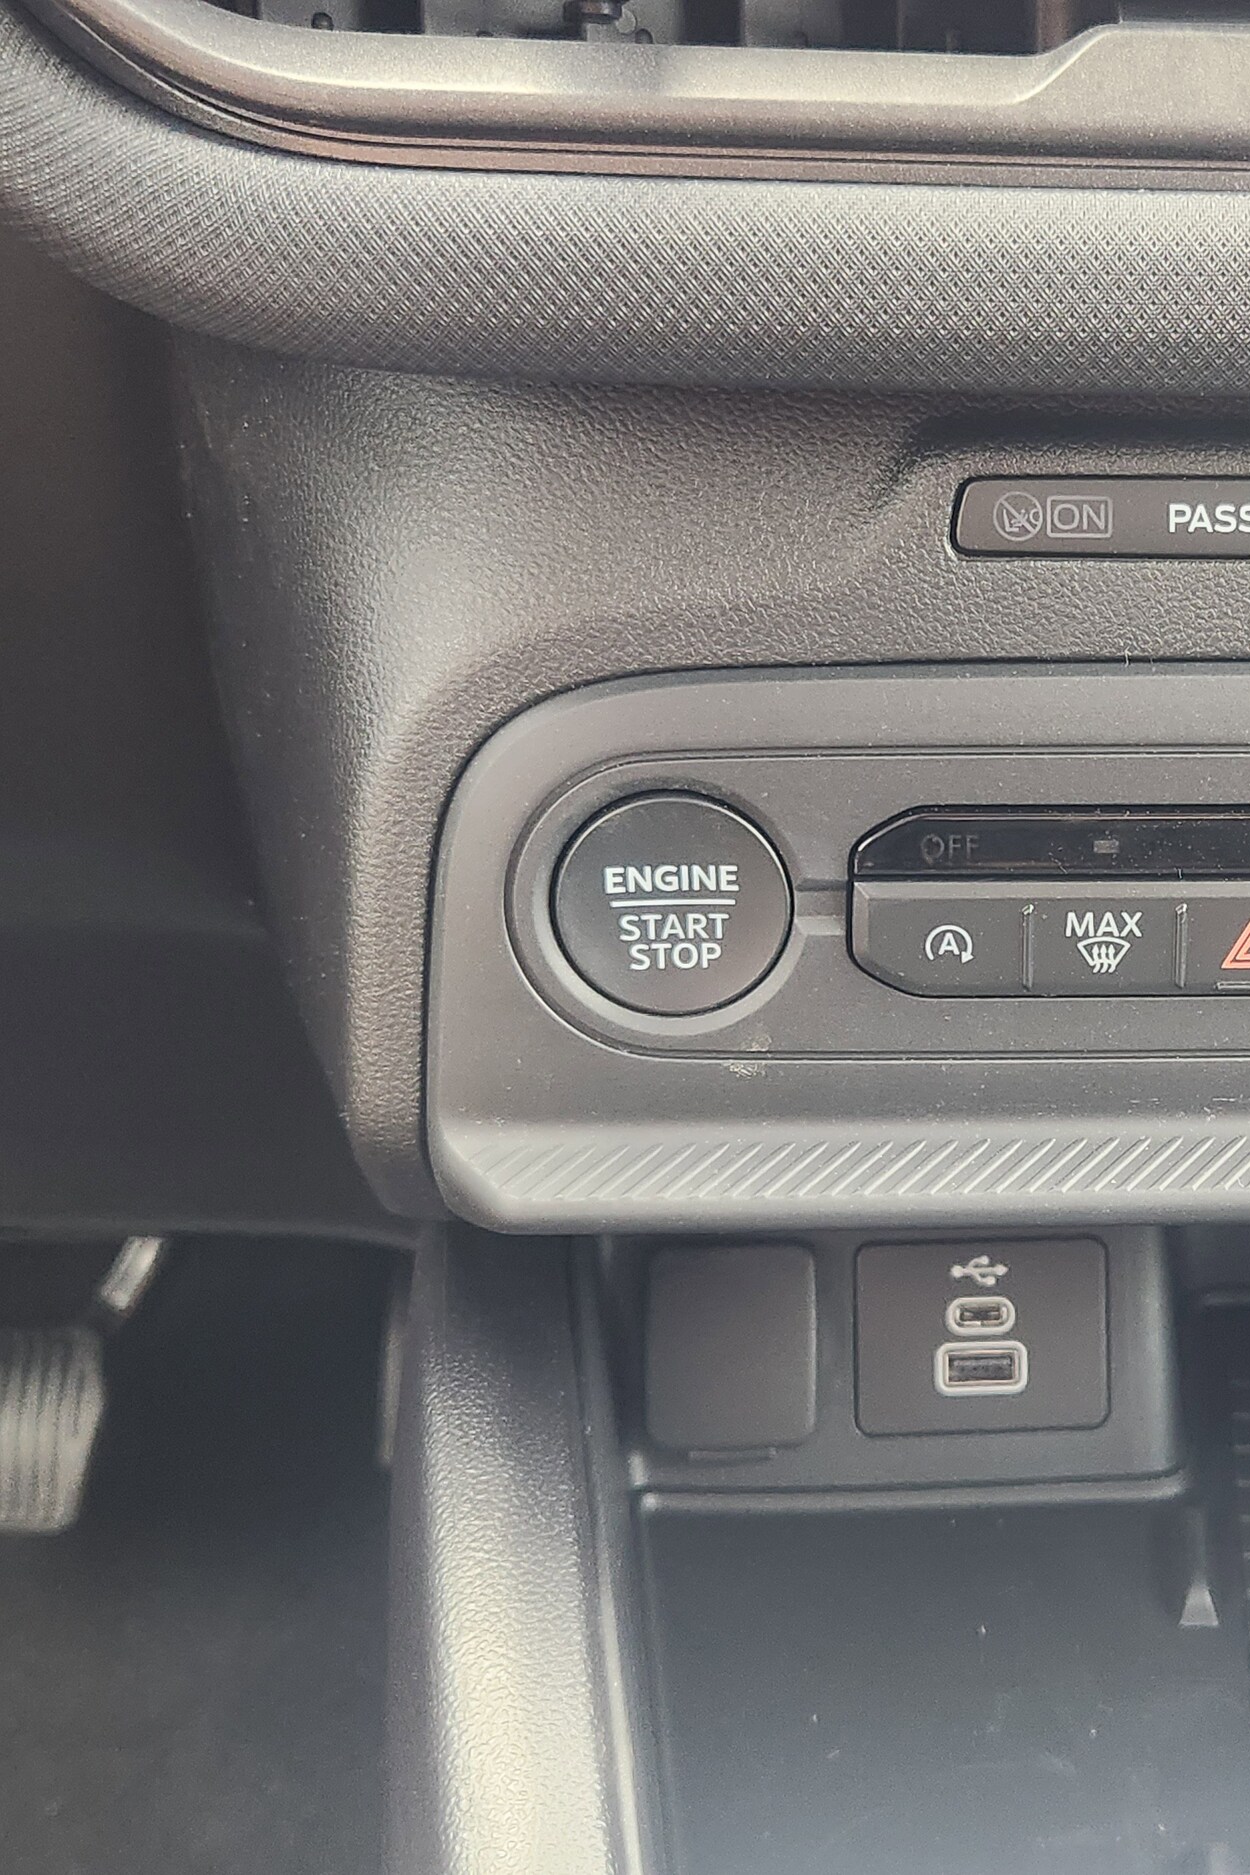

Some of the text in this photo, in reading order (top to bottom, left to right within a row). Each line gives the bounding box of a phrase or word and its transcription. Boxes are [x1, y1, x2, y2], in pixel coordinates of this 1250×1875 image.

[1053, 503, 1105, 530] ON
[921, 833, 979, 860] OFF
[604, 864, 740, 894] ENGINE
[619, 912, 730, 941] START
[1065, 911, 1143, 937] MAX
[629, 942, 722, 970] STOP
[938, 932, 960, 955] A
